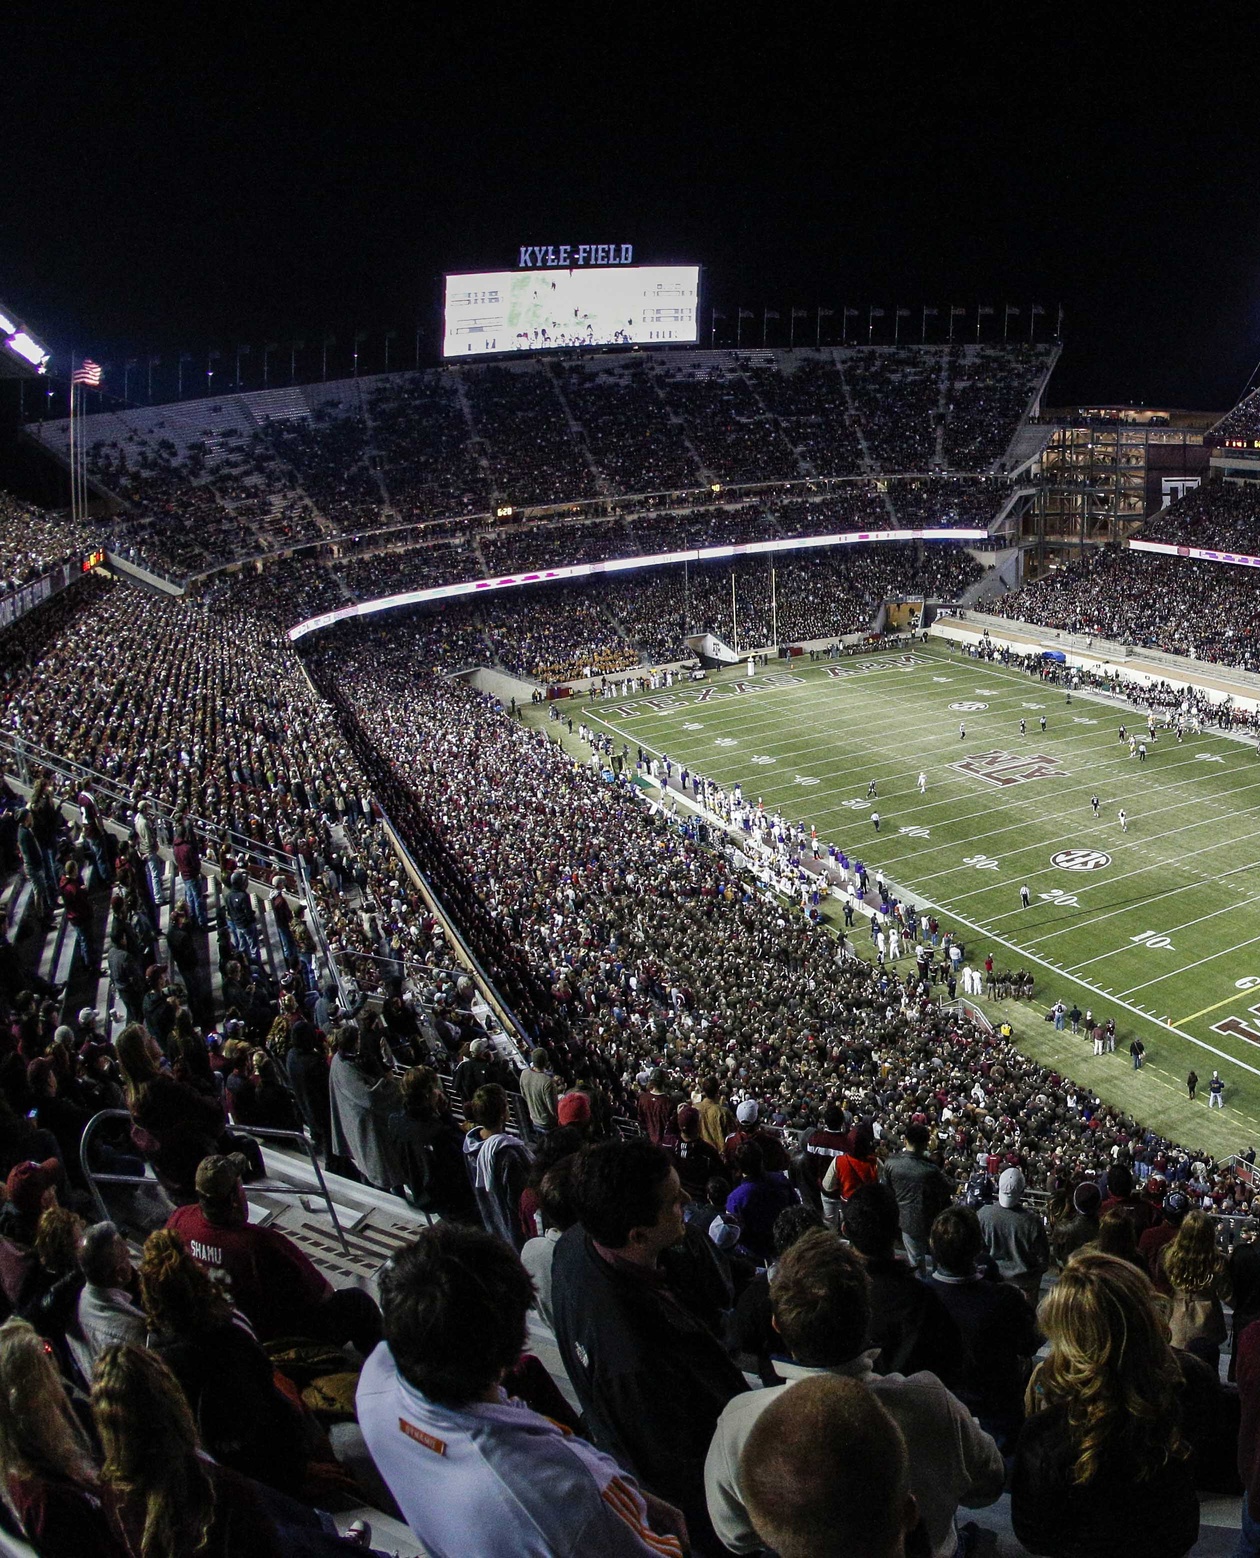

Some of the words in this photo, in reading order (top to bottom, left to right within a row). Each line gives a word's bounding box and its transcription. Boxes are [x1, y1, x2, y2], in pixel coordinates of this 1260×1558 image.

[519, 246, 571, 267] KYLE
[578, 244, 633, 265] FIELD
[599, 673, 807, 718] TEXAS
[820, 654, 934, 679] A&M
[962, 854, 999, 870] 30
[1038, 889, 1078, 906] 20
[1129, 930, 1171, 948] 10
[191, 1239, 222, 1264] SHAMU
